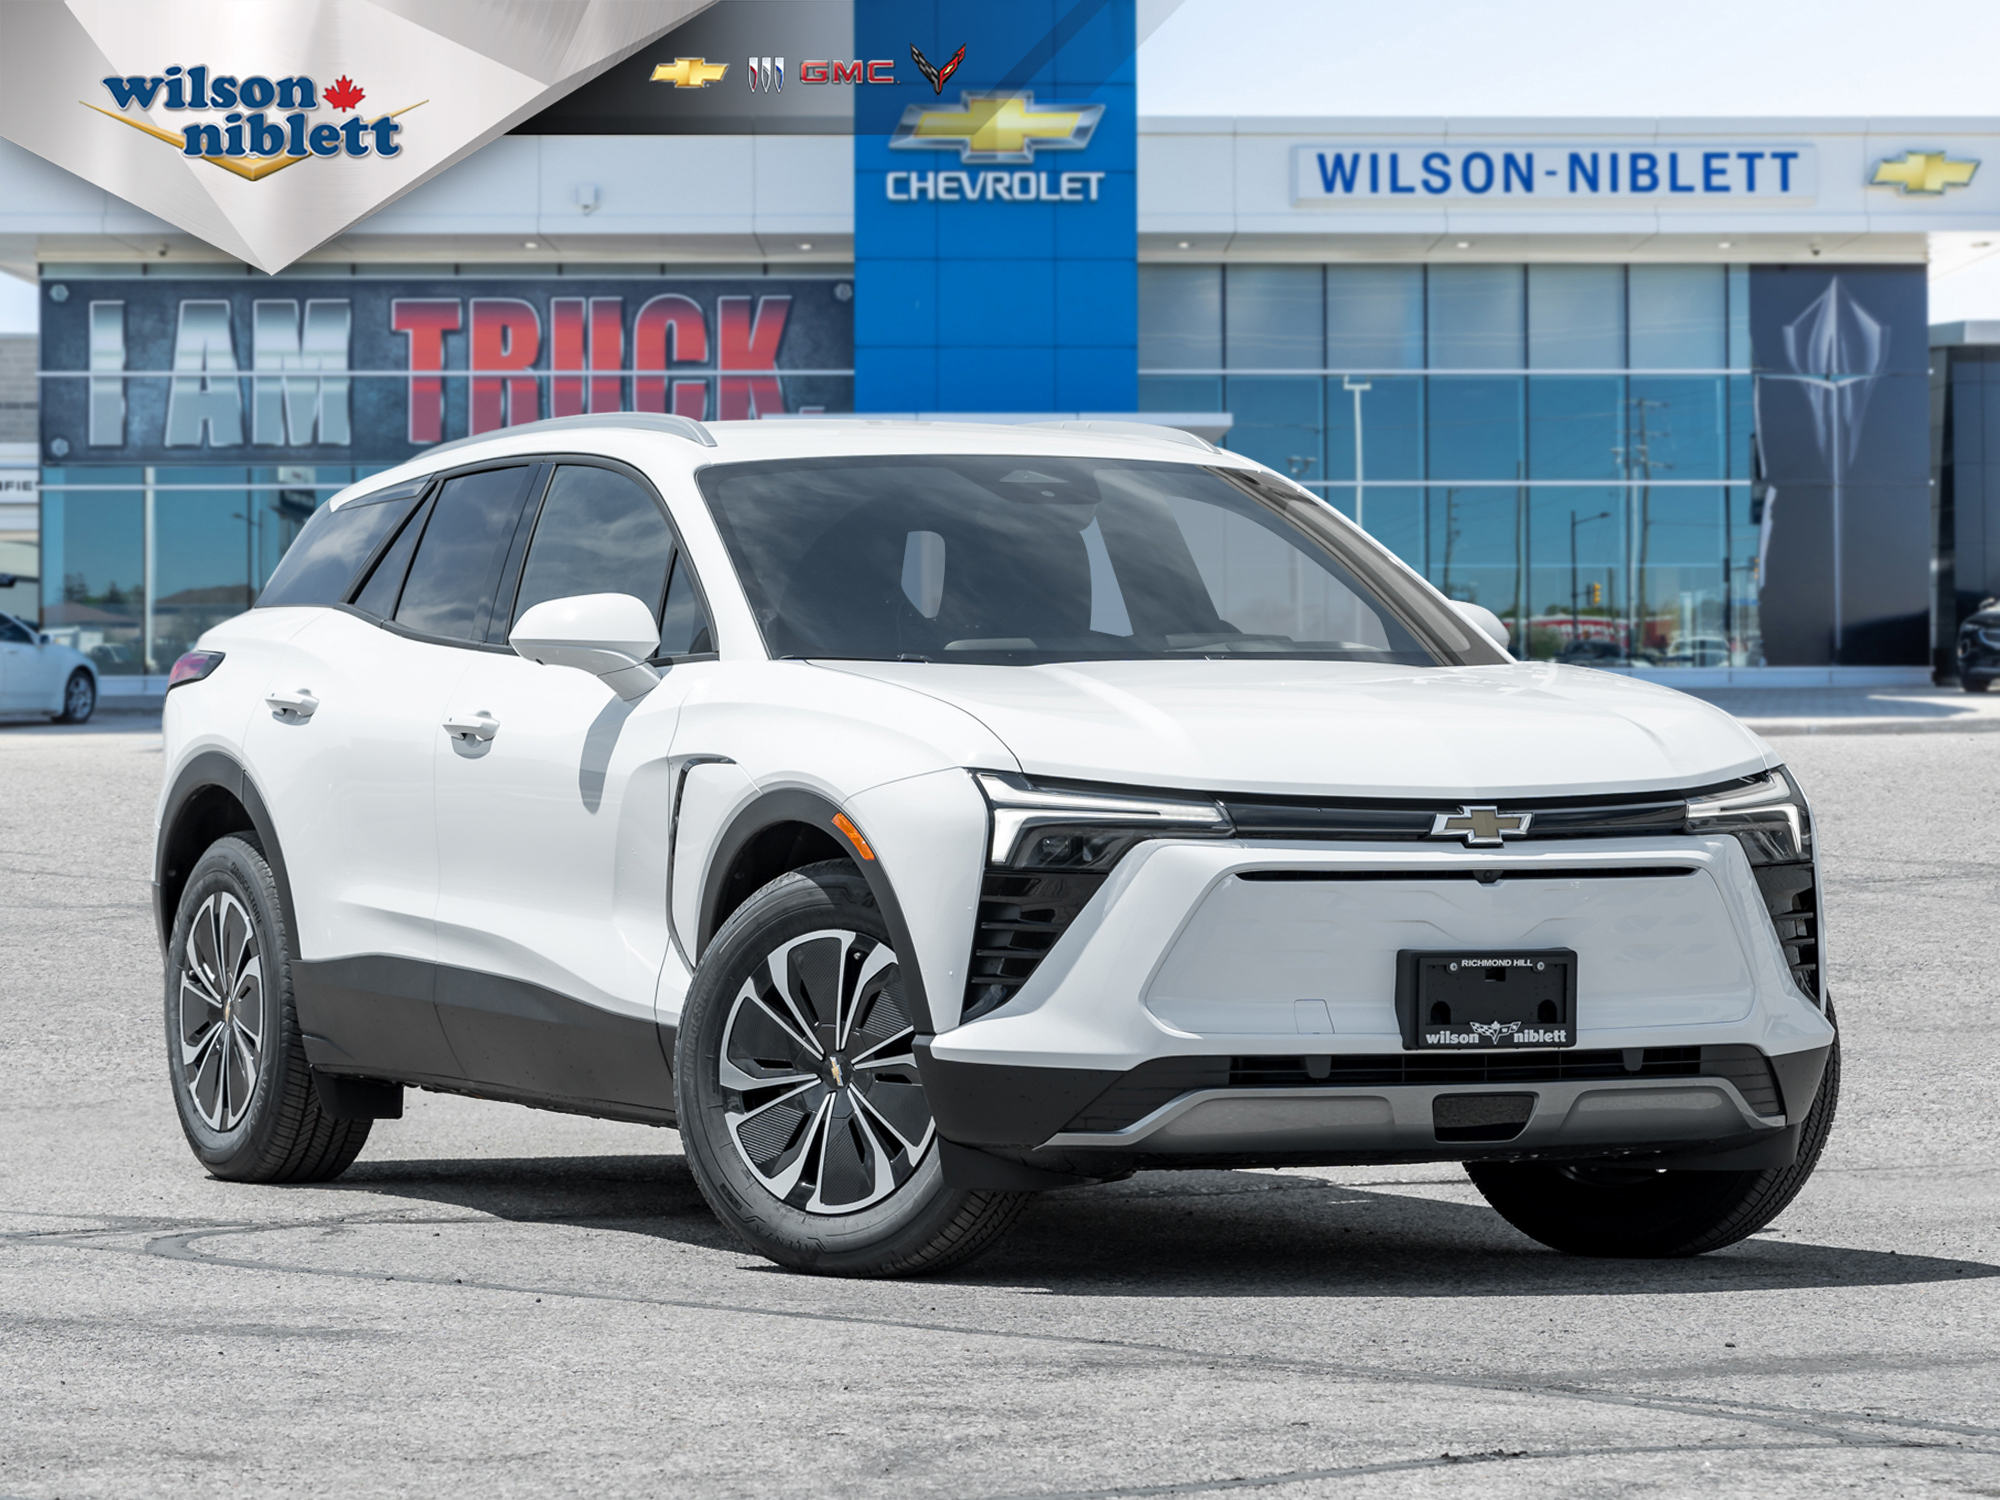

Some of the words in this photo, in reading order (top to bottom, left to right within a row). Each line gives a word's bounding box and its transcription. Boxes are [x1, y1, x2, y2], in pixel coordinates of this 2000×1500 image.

[886, 171, 1105, 201] CHEVROLET
[1316, 151, 1800, 195] WILSON-NIBLETT
[89, 300, 126, 446] I
[164, 300, 351, 447] AM
[391, 293, 793, 444] TRUCK
[1461, 959, 1512, 967] RICHMOND
[1513, 959, 1533, 967] HILL
[1425, 1030, 1479, 1044] wilson
[1513, 1029, 1567, 1043] niblett
